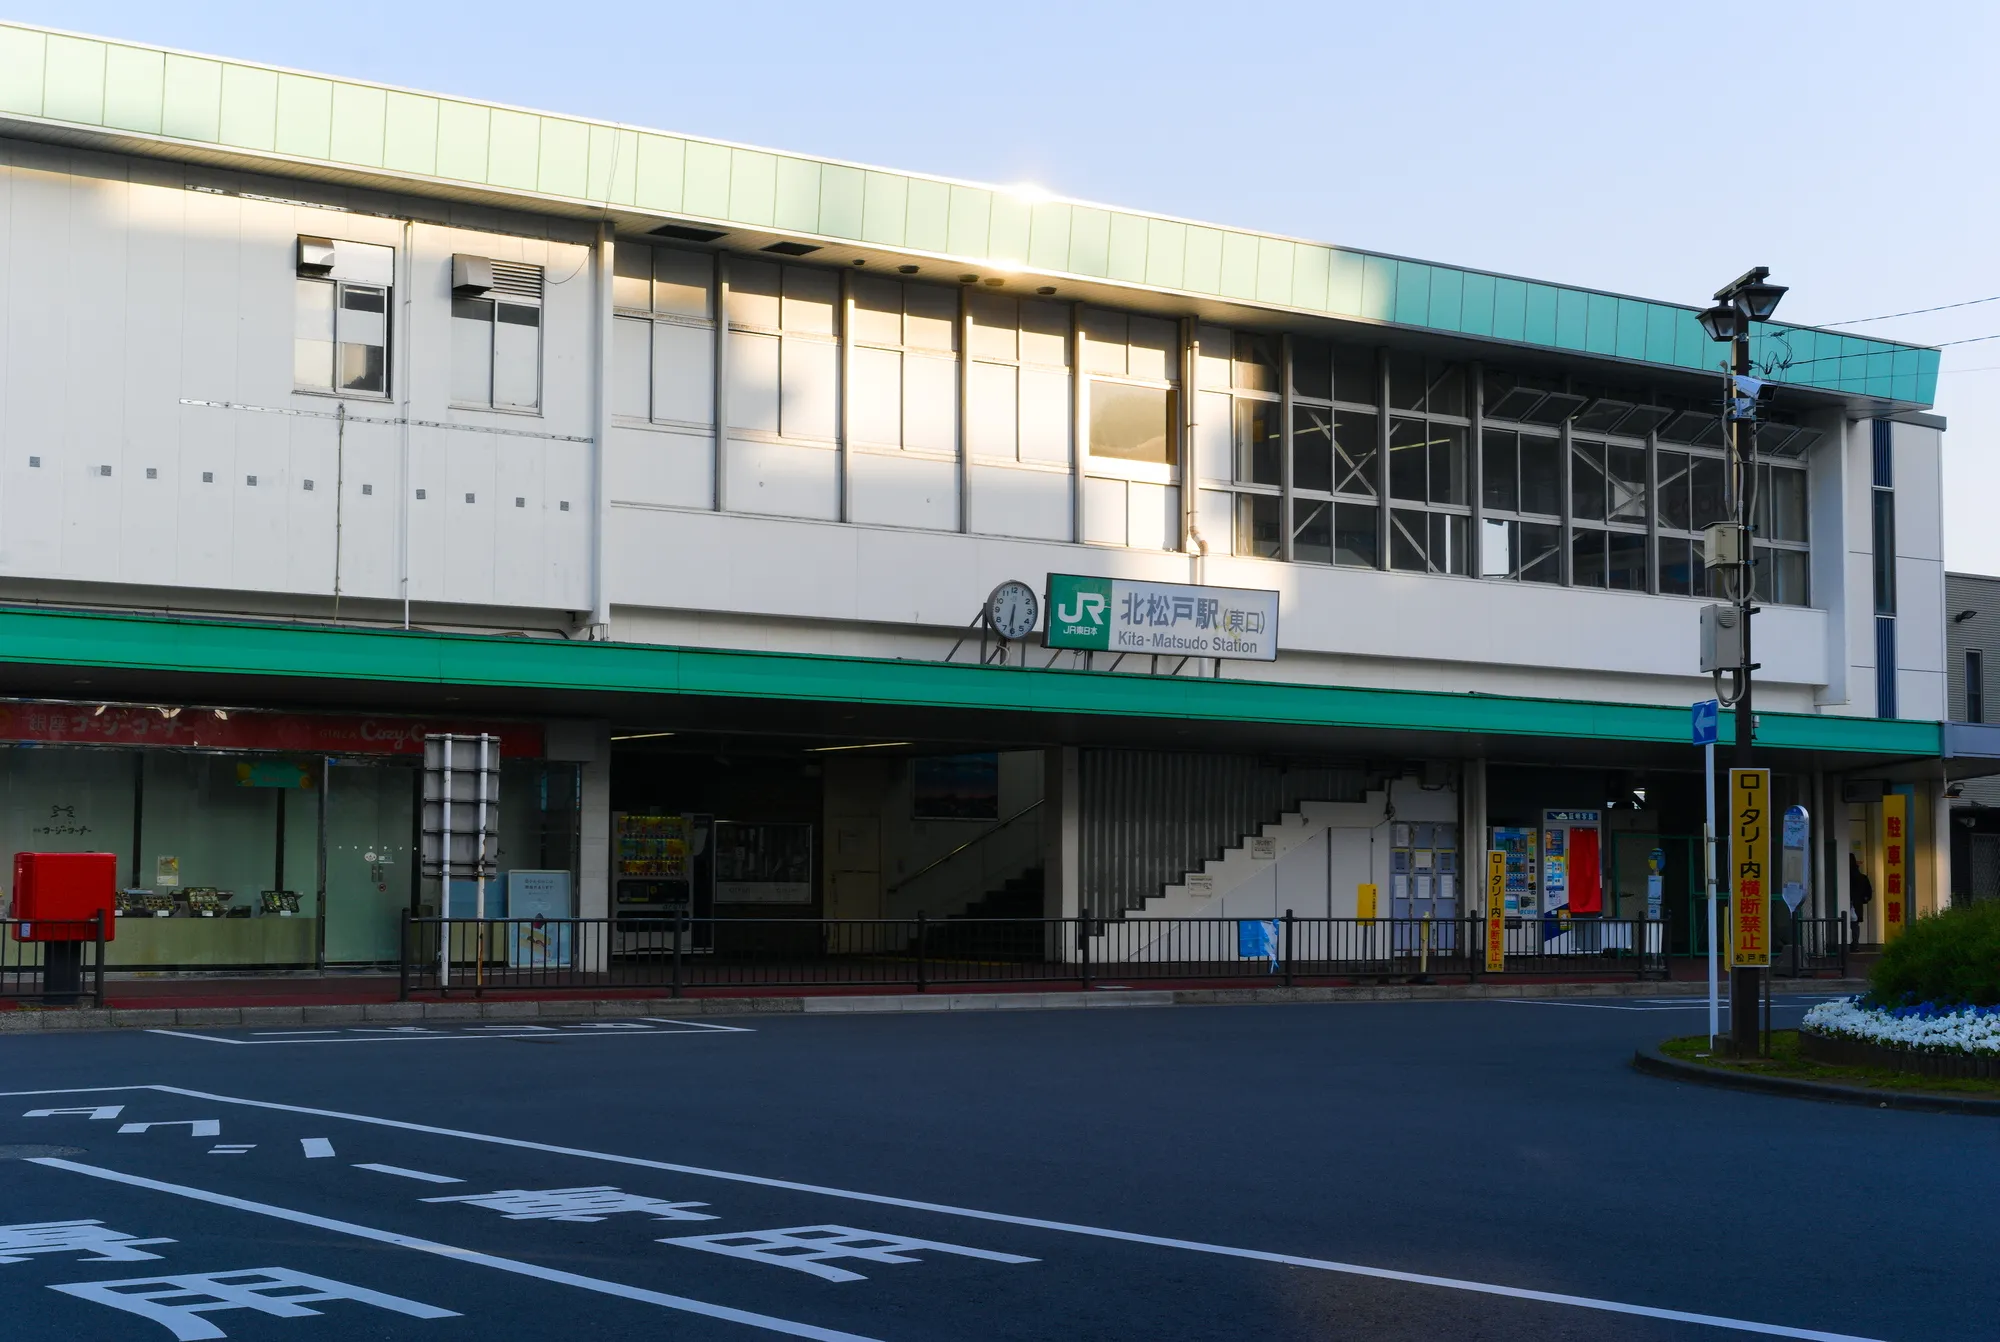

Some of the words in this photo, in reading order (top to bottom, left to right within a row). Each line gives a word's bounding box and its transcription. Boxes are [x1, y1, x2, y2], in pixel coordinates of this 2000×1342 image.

[1058, 592, 1105, 625] JR
[1063, 626, 1098, 637] JR東日本
[1118, 631, 1208, 650] Kita-Matsudo
[1212, 637, 1258, 653] Station
[1740, 773, 1761, 950] ロータリー内横断禁止
[1887, 816, 1901, 922] 駐車厳禁
[1736, 953, 1767, 963] 松戸市
